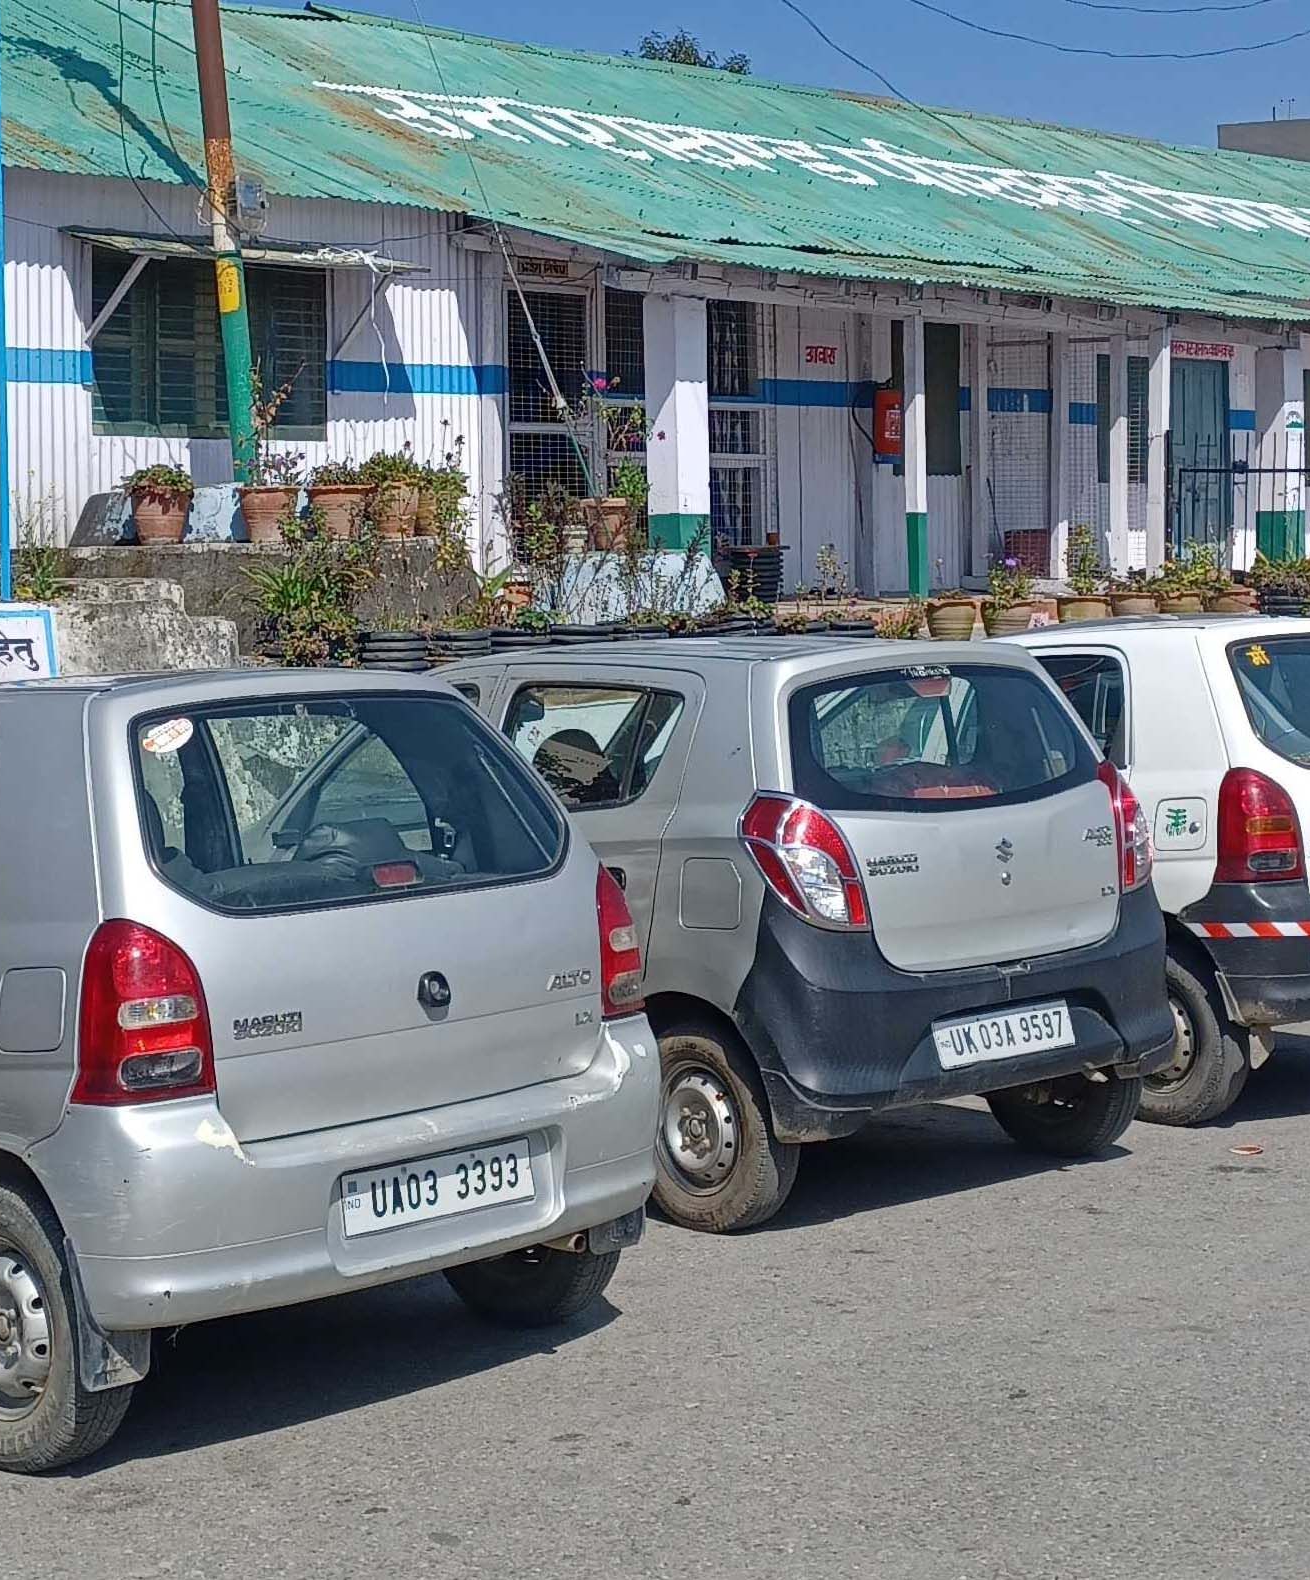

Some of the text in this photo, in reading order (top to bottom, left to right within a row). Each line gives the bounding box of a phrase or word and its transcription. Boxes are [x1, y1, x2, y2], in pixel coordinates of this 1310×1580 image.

[868, 864, 920, 877] SUZUKI
[546, 970, 593, 992] ALTO
[233, 1011, 303, 1032] MARUTI
[234, 1022, 303, 1040] SUZUKI
[949, 1010, 1063, 1056] UK 03A 9597
[371, 1169, 439, 1218] UA03
[455, 1153, 519, 1200] 3393
